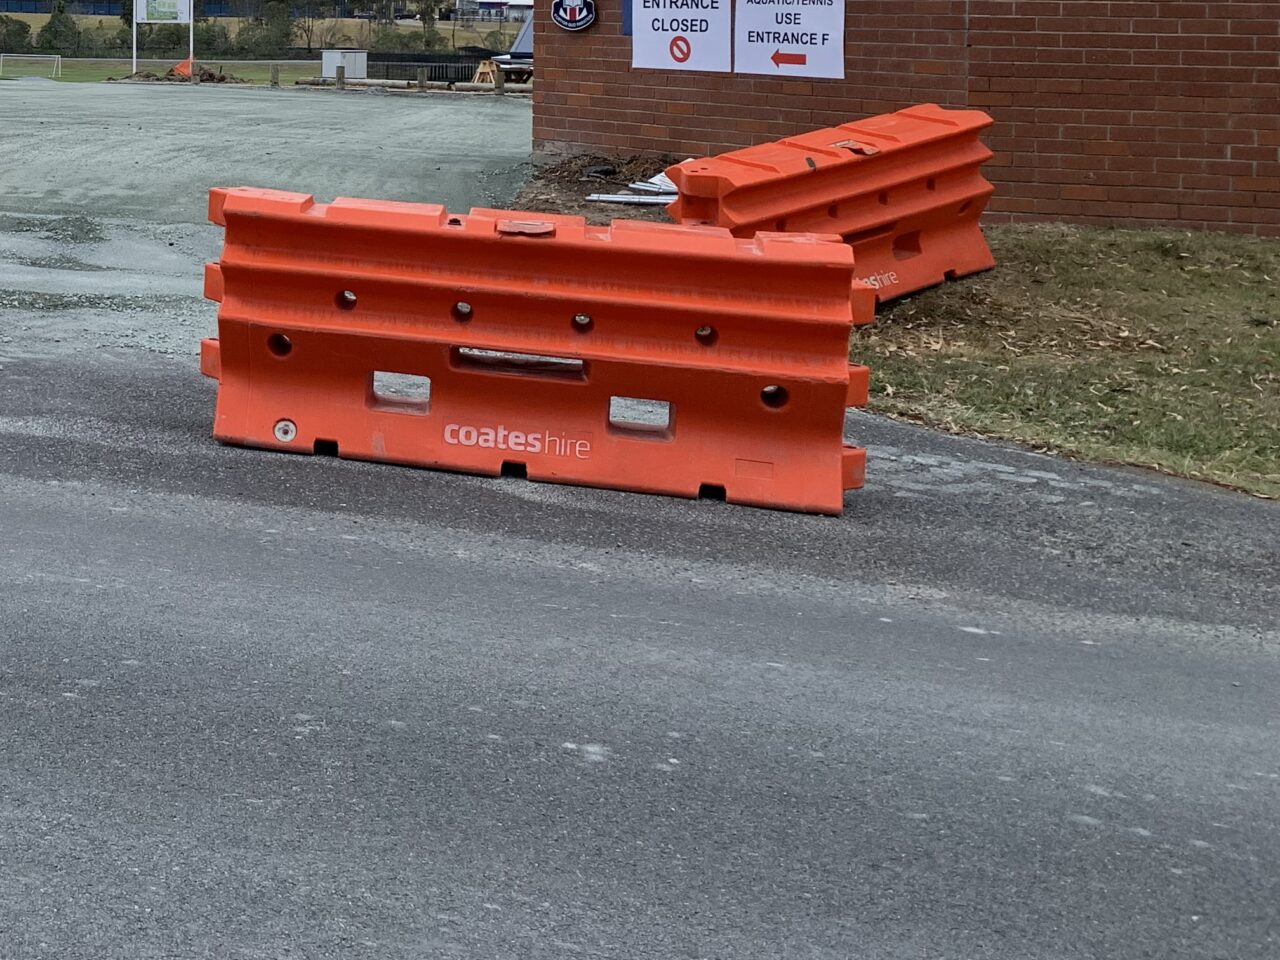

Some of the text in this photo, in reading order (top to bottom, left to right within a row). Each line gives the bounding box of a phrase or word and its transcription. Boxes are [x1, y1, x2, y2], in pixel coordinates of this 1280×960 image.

[651, 18, 709, 33] CLOSED
[775, 12, 801, 25] USE
[748, 30, 830, 46] ENTRANCE F
[444, 423, 591, 459] coateshire
